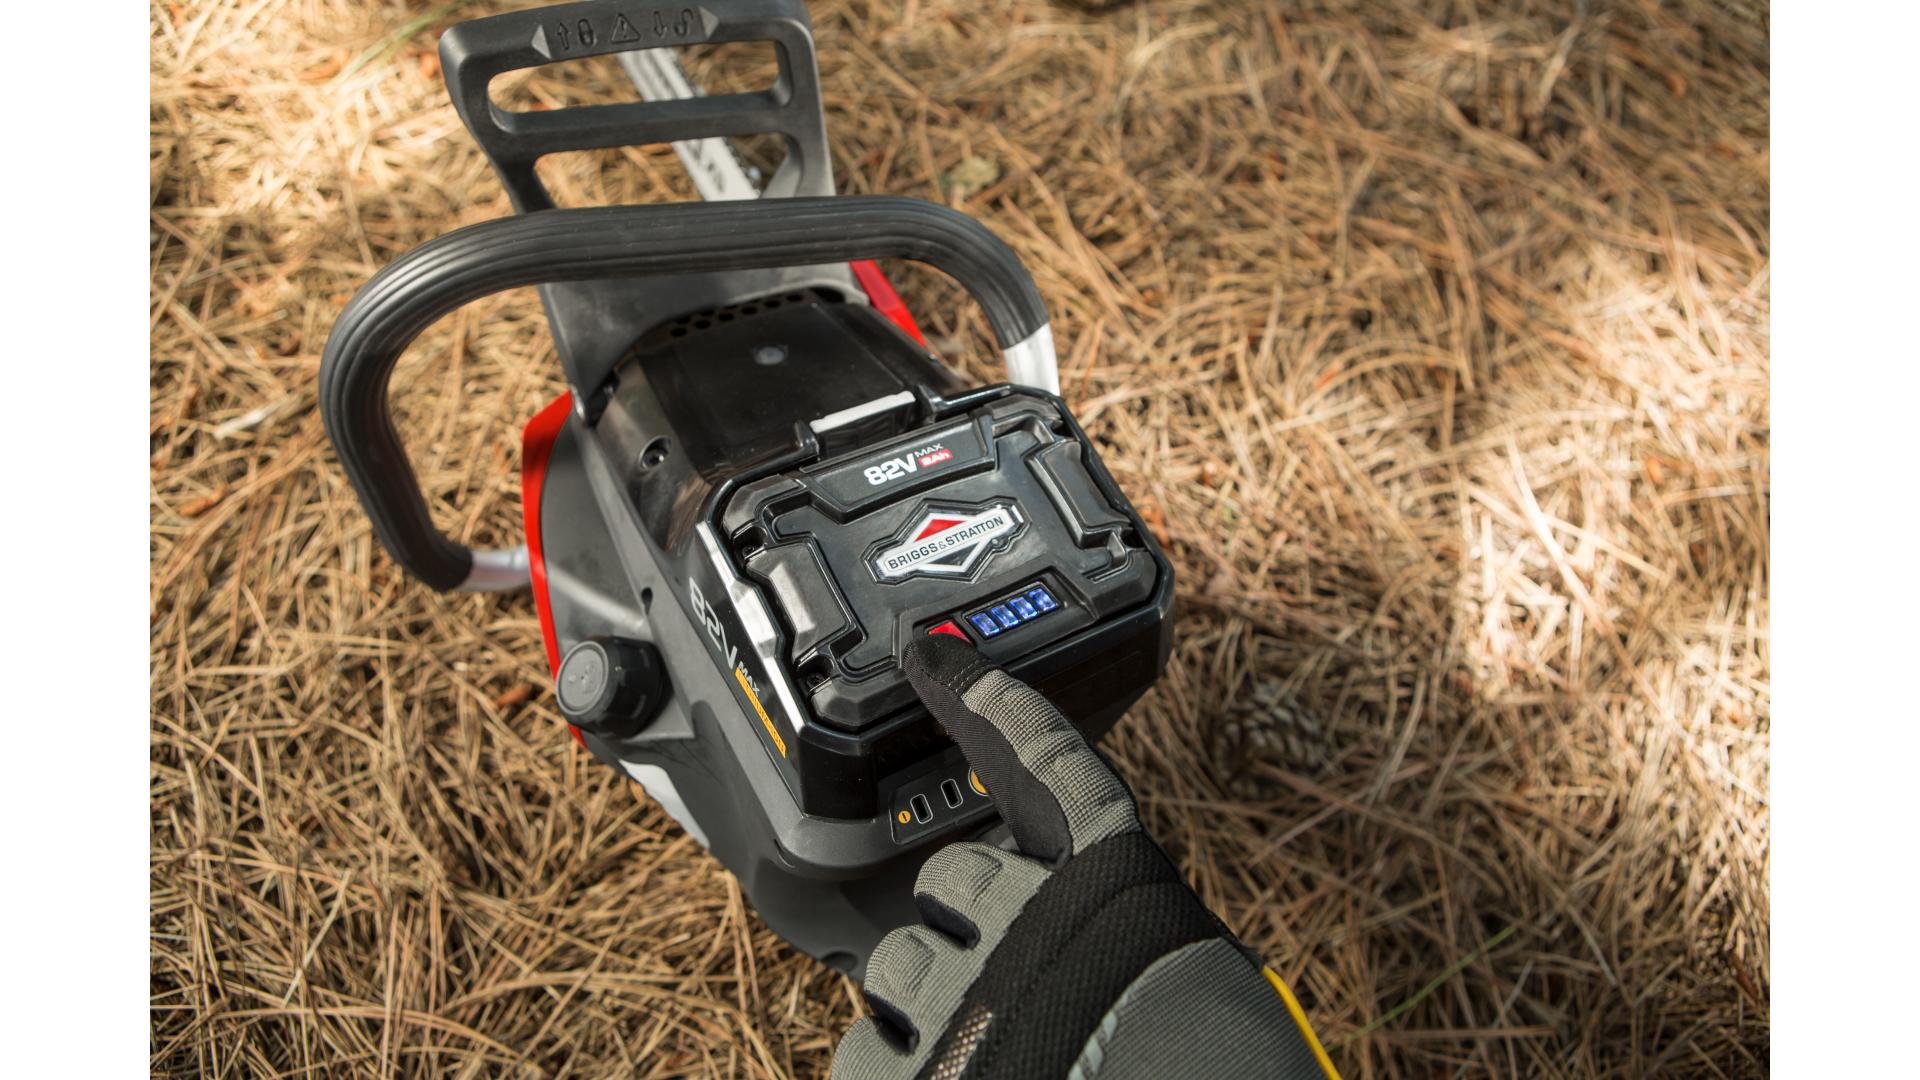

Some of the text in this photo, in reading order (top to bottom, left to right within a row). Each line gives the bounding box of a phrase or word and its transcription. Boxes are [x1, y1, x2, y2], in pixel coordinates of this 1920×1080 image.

[864, 443, 944, 486] 82V MAX
[689, 577, 760, 697] 82V MAX
